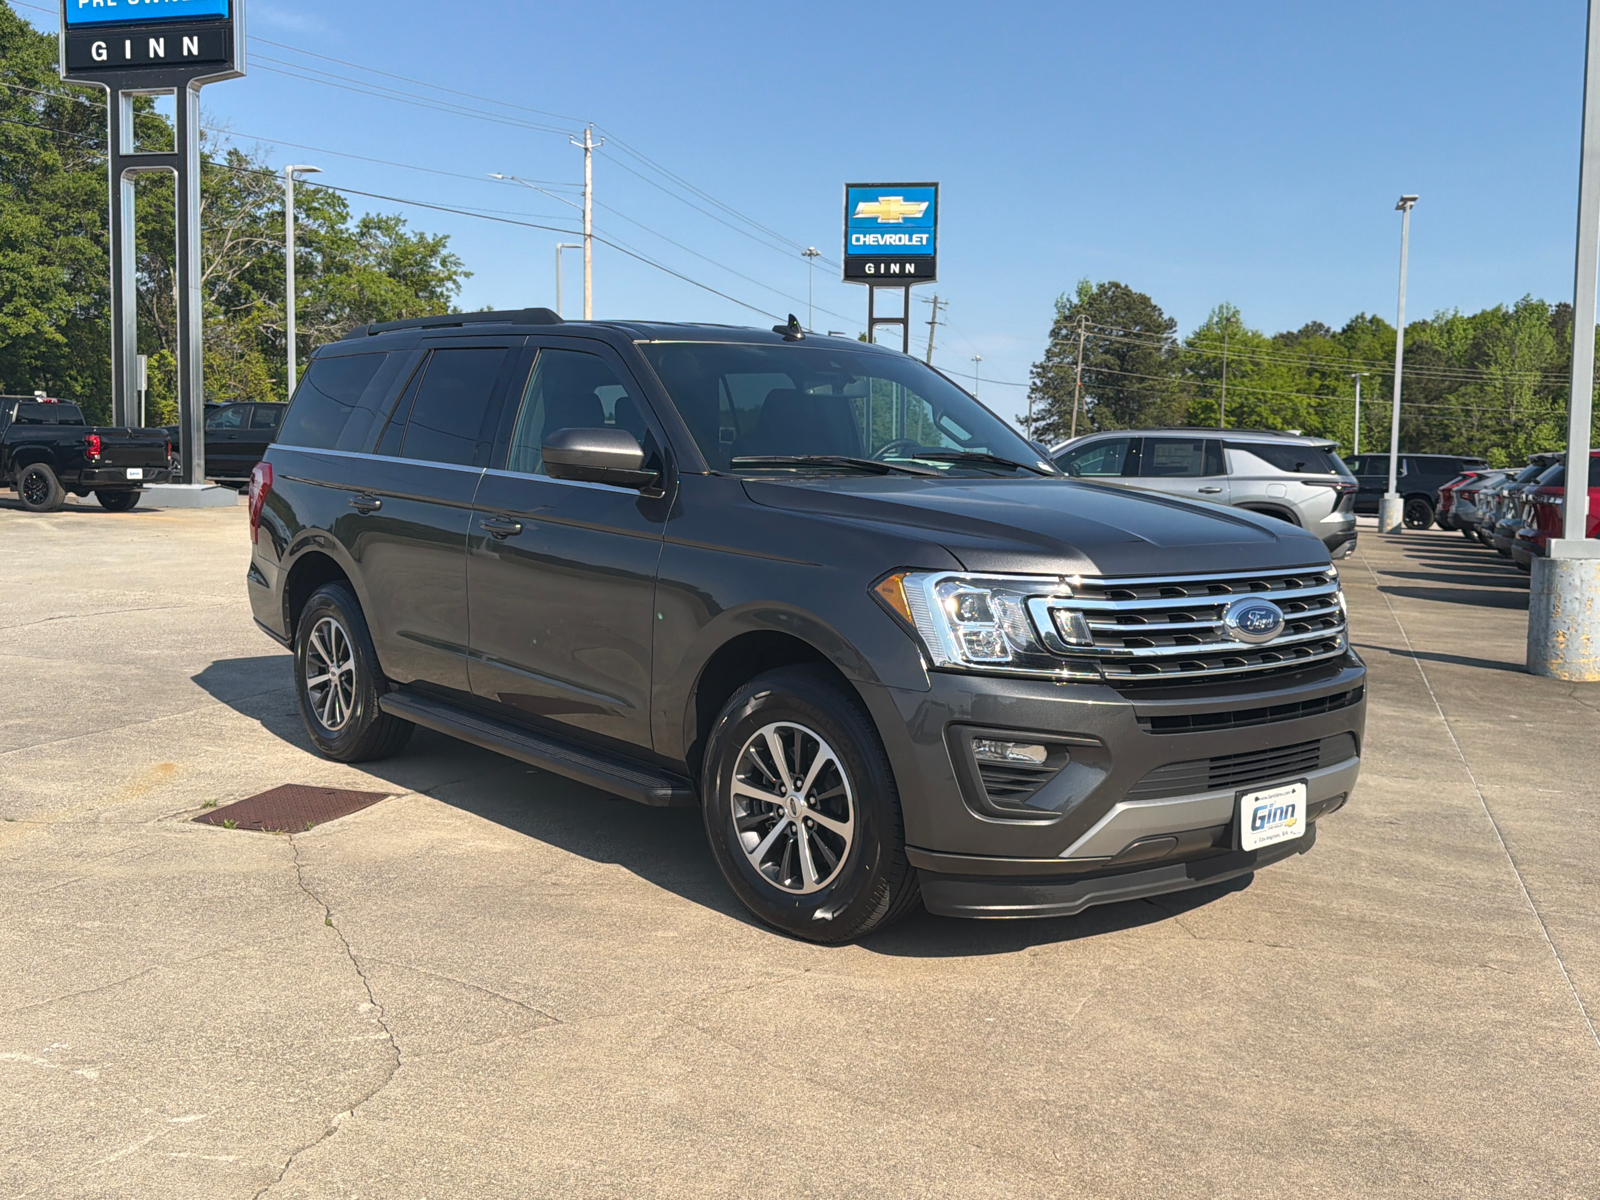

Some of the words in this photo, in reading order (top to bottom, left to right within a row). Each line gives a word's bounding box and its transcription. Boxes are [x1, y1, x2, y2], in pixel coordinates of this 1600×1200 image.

[91, 36, 199, 61] GINN
[851, 234, 929, 245] CHEVROLET
[865, 263, 915, 274] GINN
[1247, 610, 1274, 629] Ford
[1251, 803, 1296, 832] Ginn
